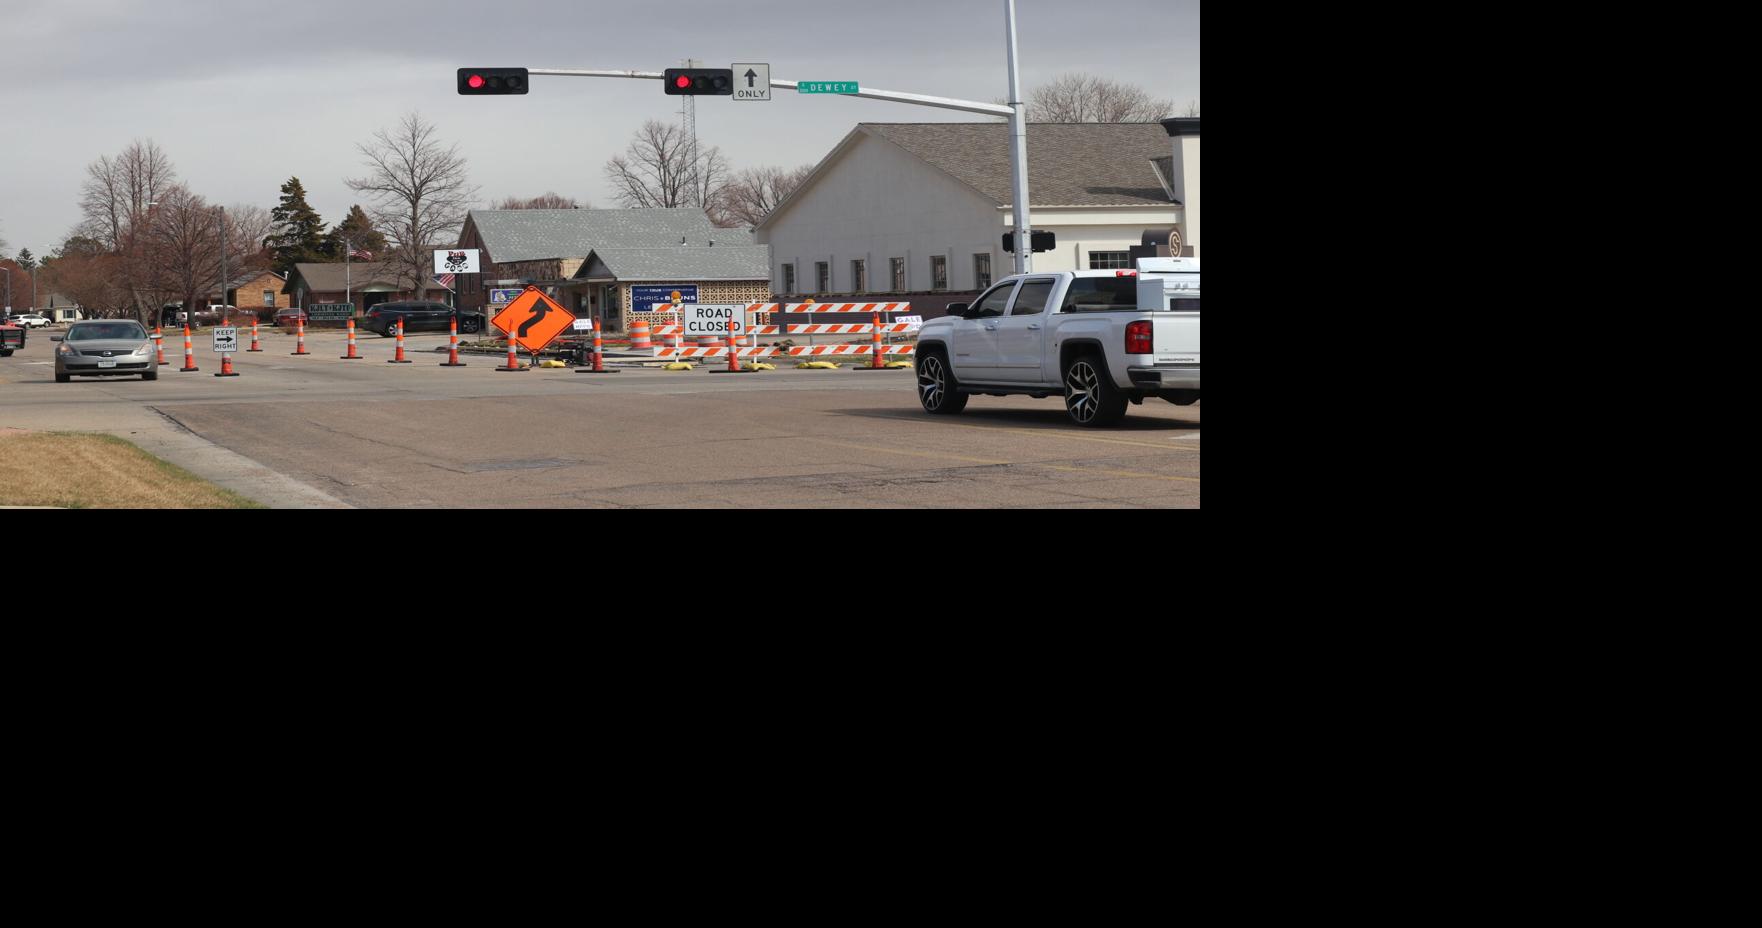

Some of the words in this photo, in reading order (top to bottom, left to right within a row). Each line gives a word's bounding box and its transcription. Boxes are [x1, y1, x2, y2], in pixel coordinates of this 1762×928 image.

[810, 83, 847, 92] DEWEY
[738, 90, 765, 98] ONLY
[696, 308, 733, 318] ROAD
